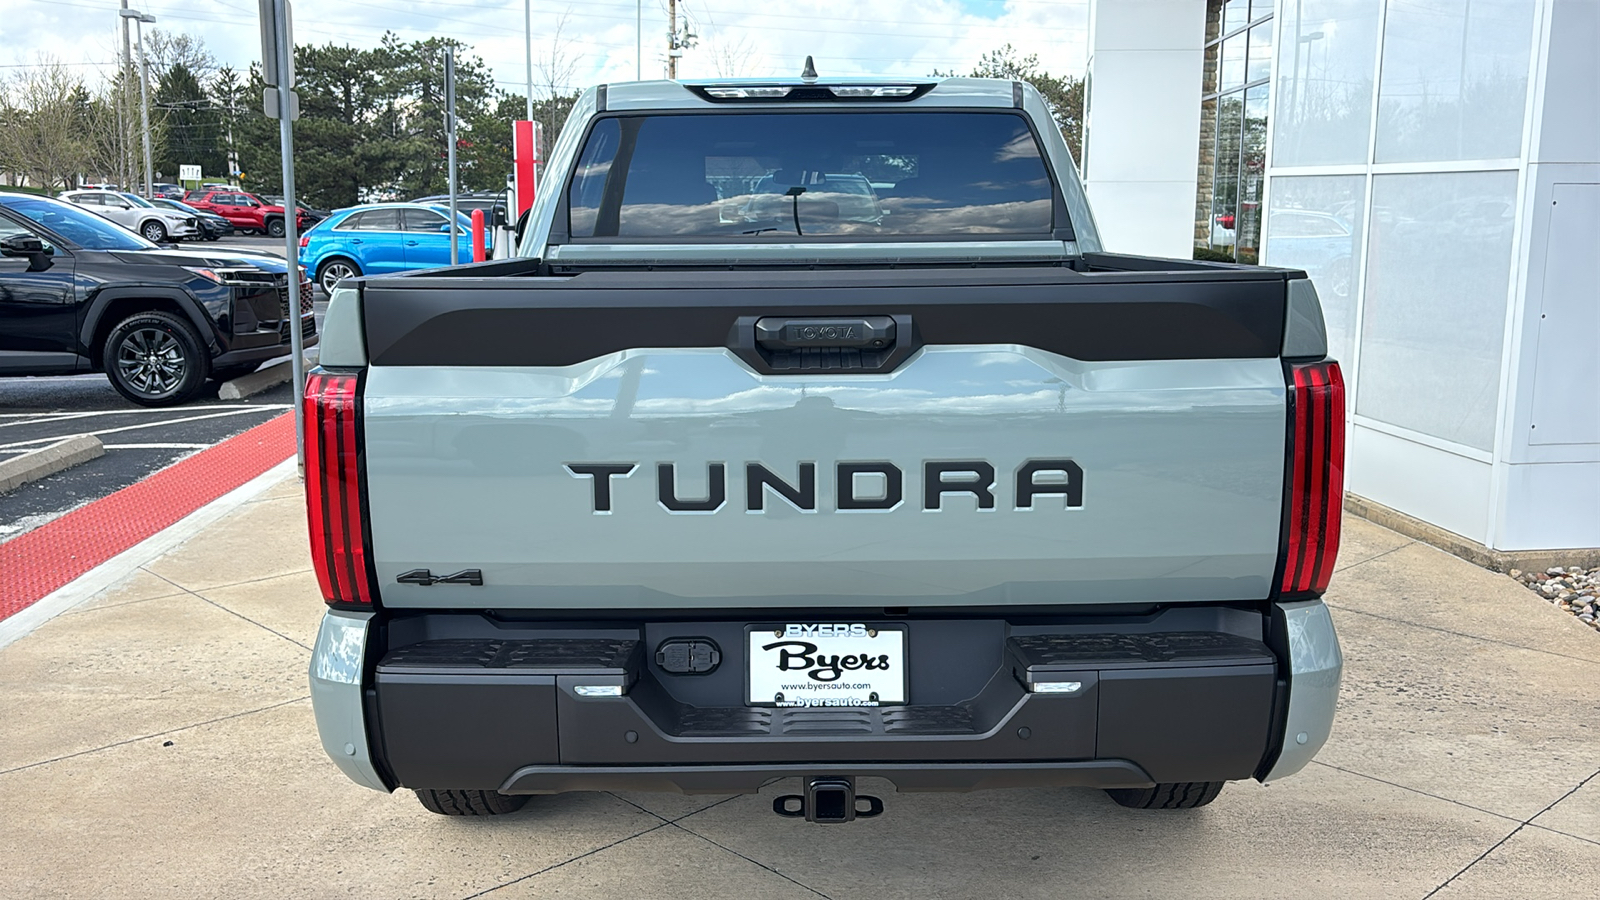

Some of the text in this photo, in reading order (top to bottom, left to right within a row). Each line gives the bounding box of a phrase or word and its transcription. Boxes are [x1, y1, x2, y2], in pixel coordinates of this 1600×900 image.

[794, 326, 859, 340] TOYOTA
[562, 459, 1085, 516] TUNDRA
[785, 623, 867, 638] BYERS
[761, 640, 890, 682] Byers
[781, 681, 871, 692] www.byersauto.com
[776, 697, 879, 708] www.byersauto.com
